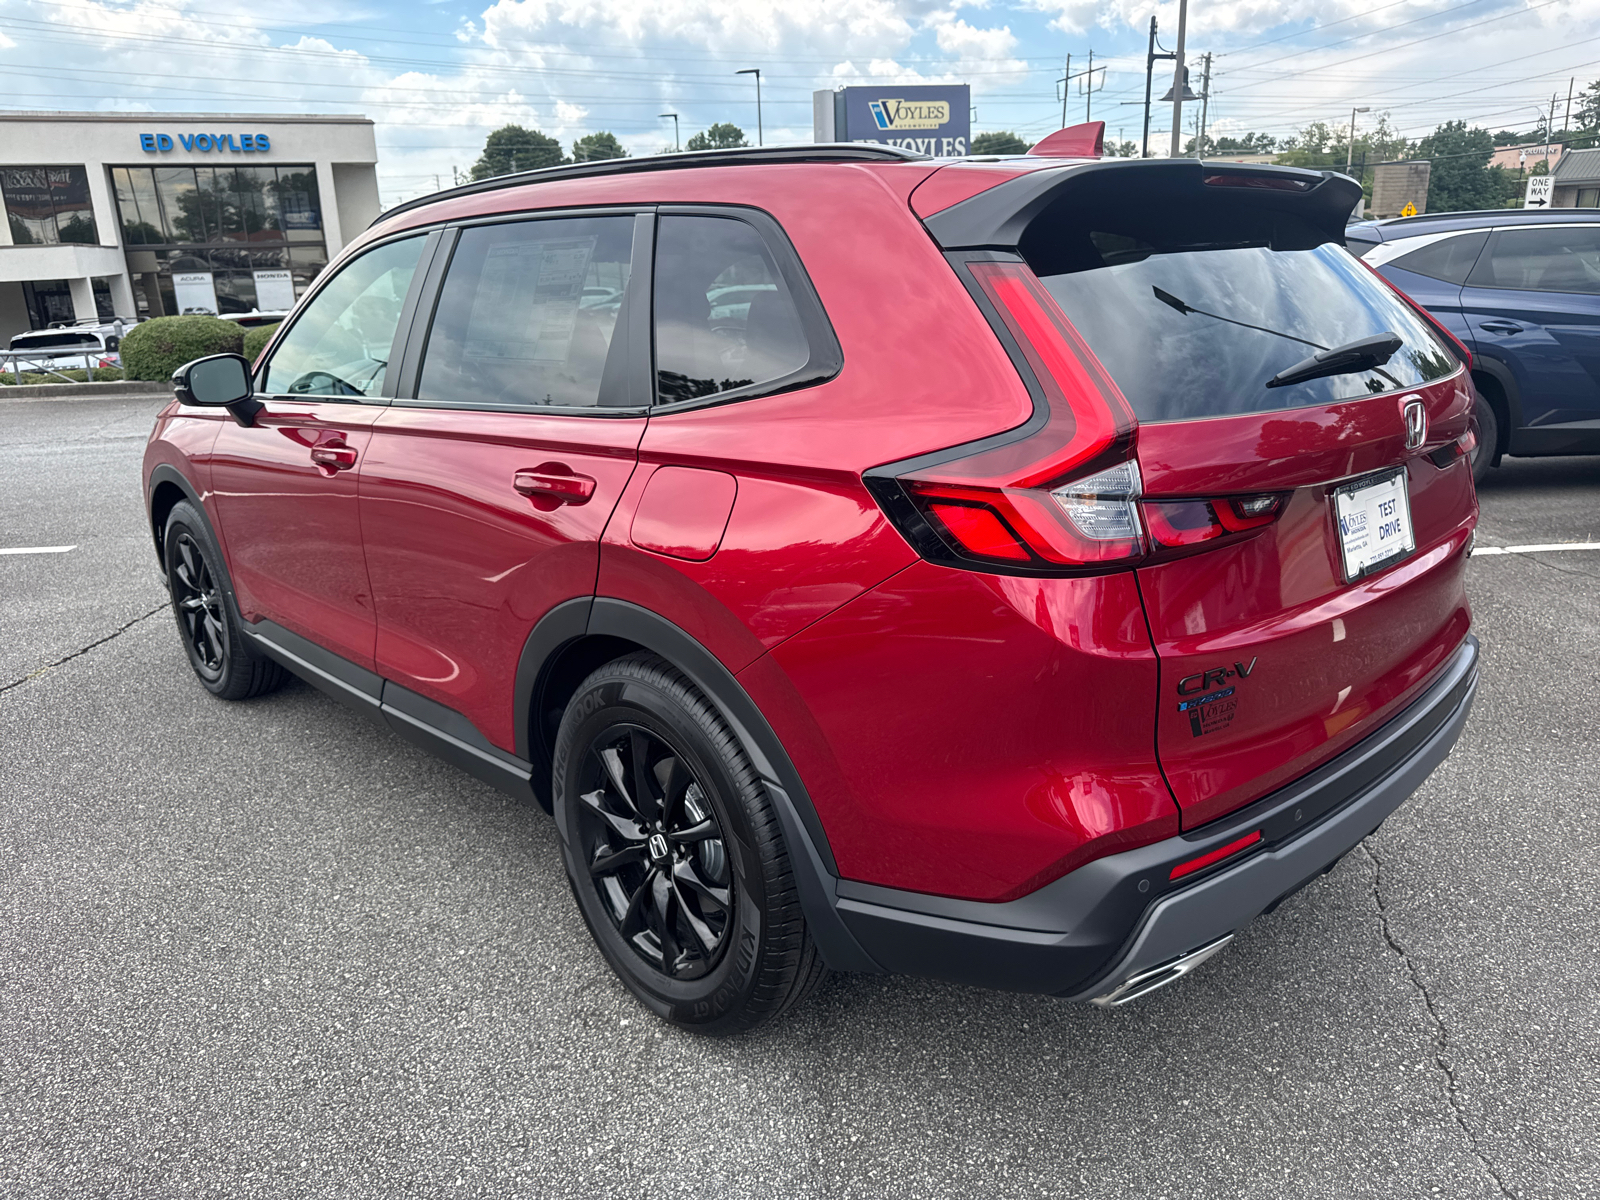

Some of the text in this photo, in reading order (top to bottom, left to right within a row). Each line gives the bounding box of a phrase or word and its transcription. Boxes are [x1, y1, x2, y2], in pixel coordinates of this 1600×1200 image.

[880, 100, 945, 126] VOYLES
[139, 133, 271, 152] ED VOYLES
[1530, 187, 1549, 196] WAY
[1532, 178, 1550, 187] ONE
[1378, 498, 1396, 518] TEST
[1342, 512, 1367, 535] VOYLES
[1378, 518, 1402, 540] DRIVE
[1177, 656, 1257, 695] CR-V
[1200, 700, 1238, 724] VOYLES
